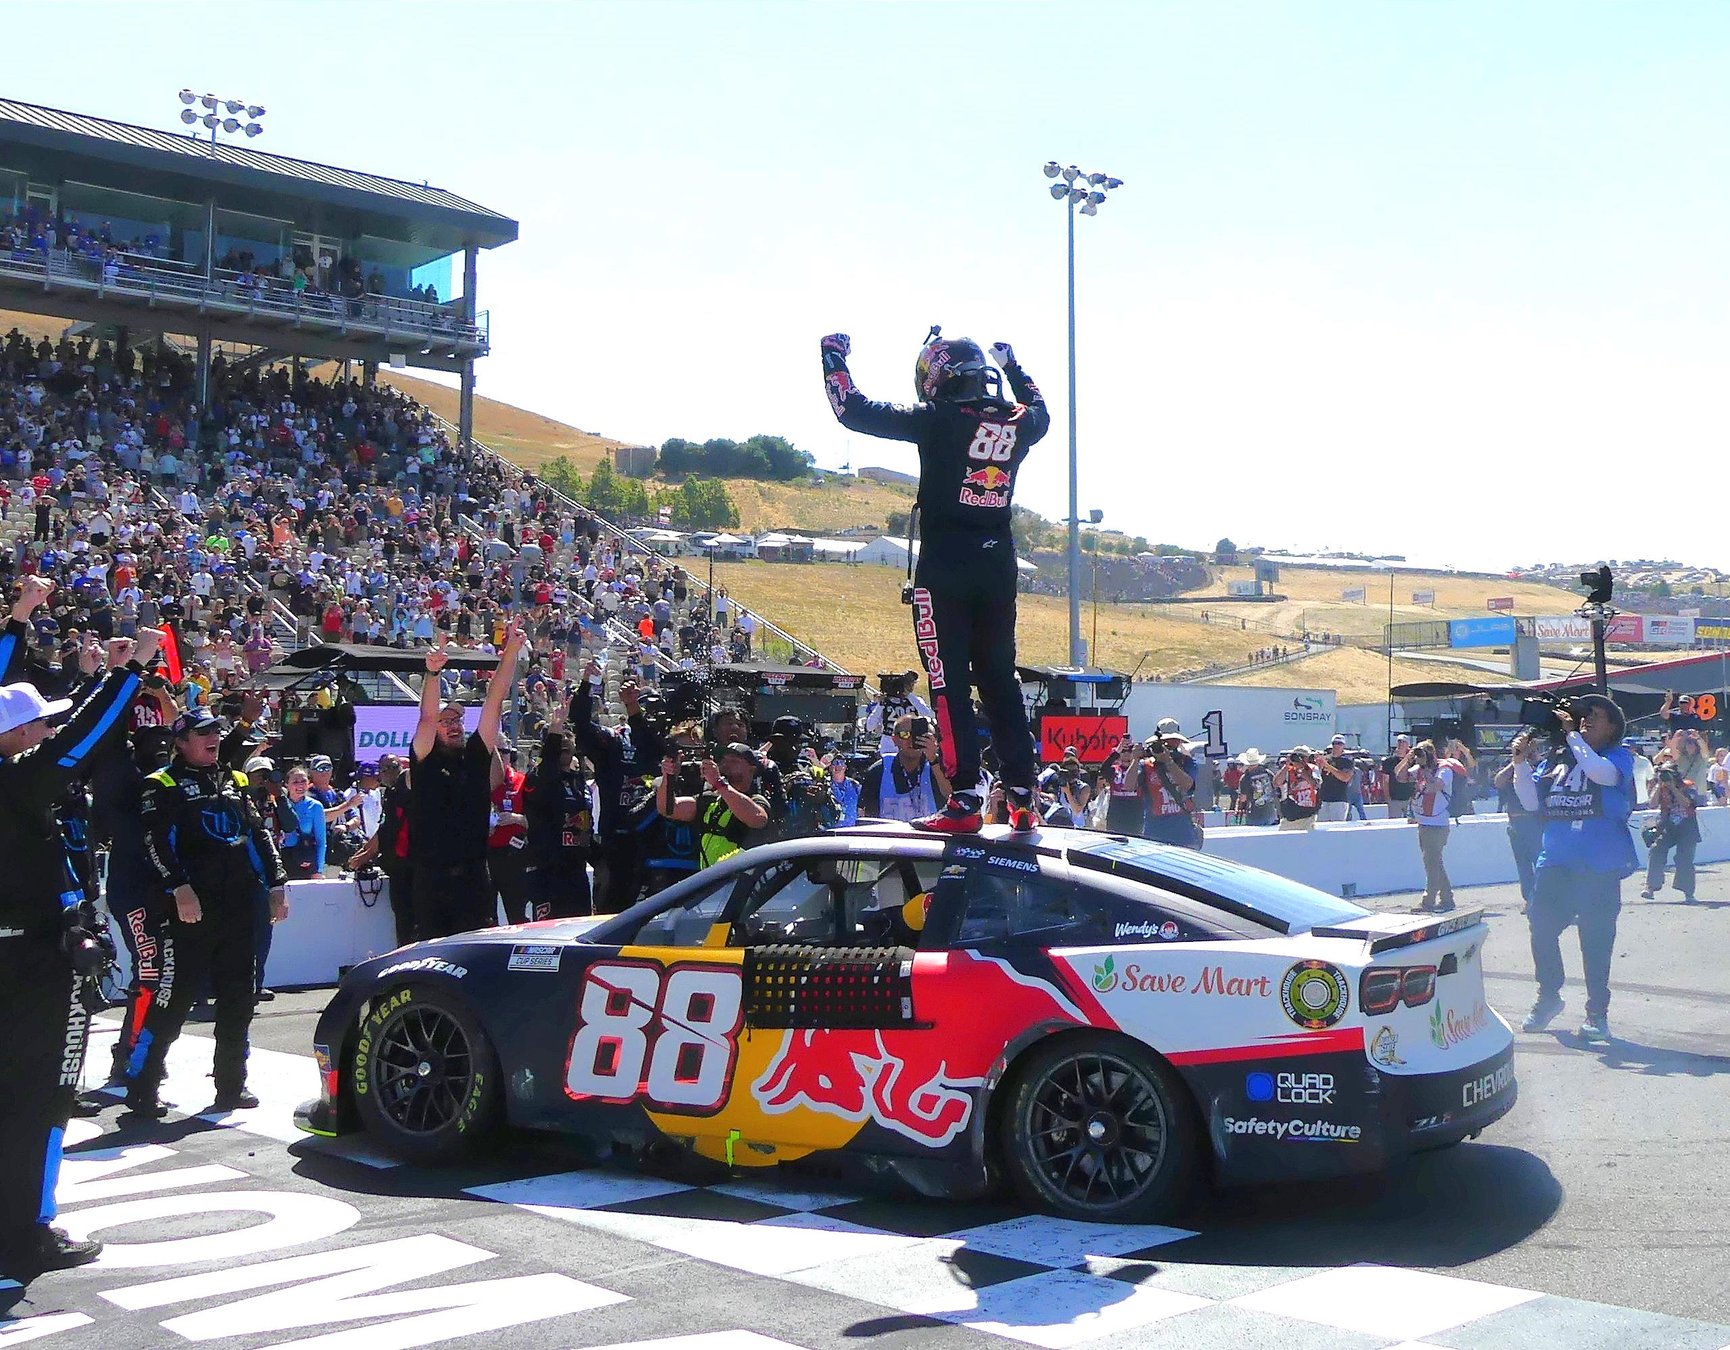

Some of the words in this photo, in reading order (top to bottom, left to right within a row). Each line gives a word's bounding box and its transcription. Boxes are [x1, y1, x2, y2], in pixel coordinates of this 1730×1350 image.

[968, 421, 1017, 461] 88
[1284, 711, 1332, 722] SONSRAY
[358, 731, 412, 748] DOLL
[1047, 727, 1119, 754] Kubota
[1202, 710, 1228, 757] 1
[987, 856, 1039, 873] SIEMENS
[1115, 920, 1159, 939] Wendy's
[377, 957, 468, 979] GOODYEAR
[1122, 964, 1186, 992] Save
[1190, 966, 1272, 997] Mart
[564, 960, 743, 1114] 88
[1277, 1072, 1334, 1089] QUAD
[1224, 1116, 1362, 1140] SafetyCulture
